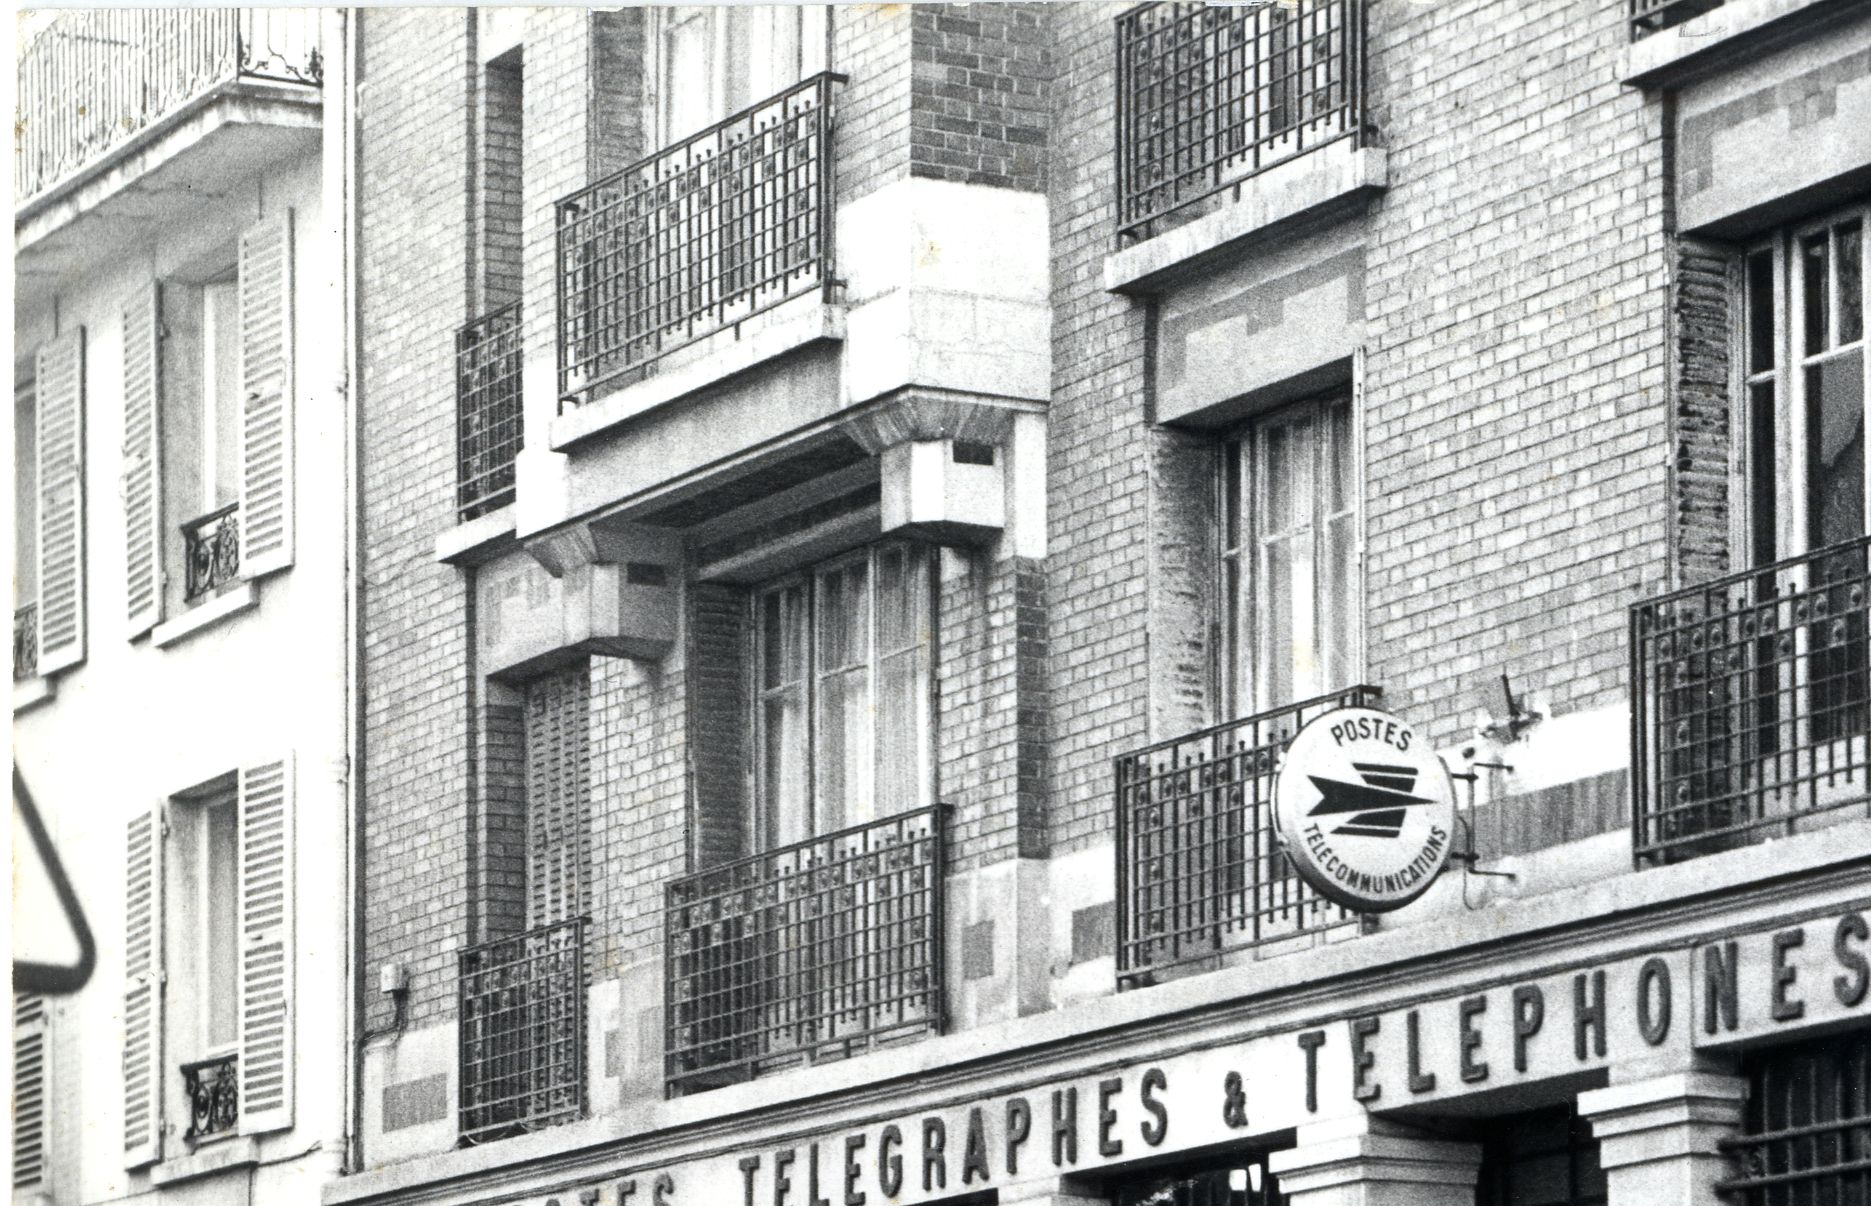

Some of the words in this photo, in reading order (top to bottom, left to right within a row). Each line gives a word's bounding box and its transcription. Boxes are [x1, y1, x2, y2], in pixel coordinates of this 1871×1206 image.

[1330, 716, 1413, 752] POSTES
[1303, 822, 1447, 895] TELECOMMUNICATIONS
[1223, 1070, 1249, 1129] &
[1298, 911, 1871, 1114] TELEPHONES
